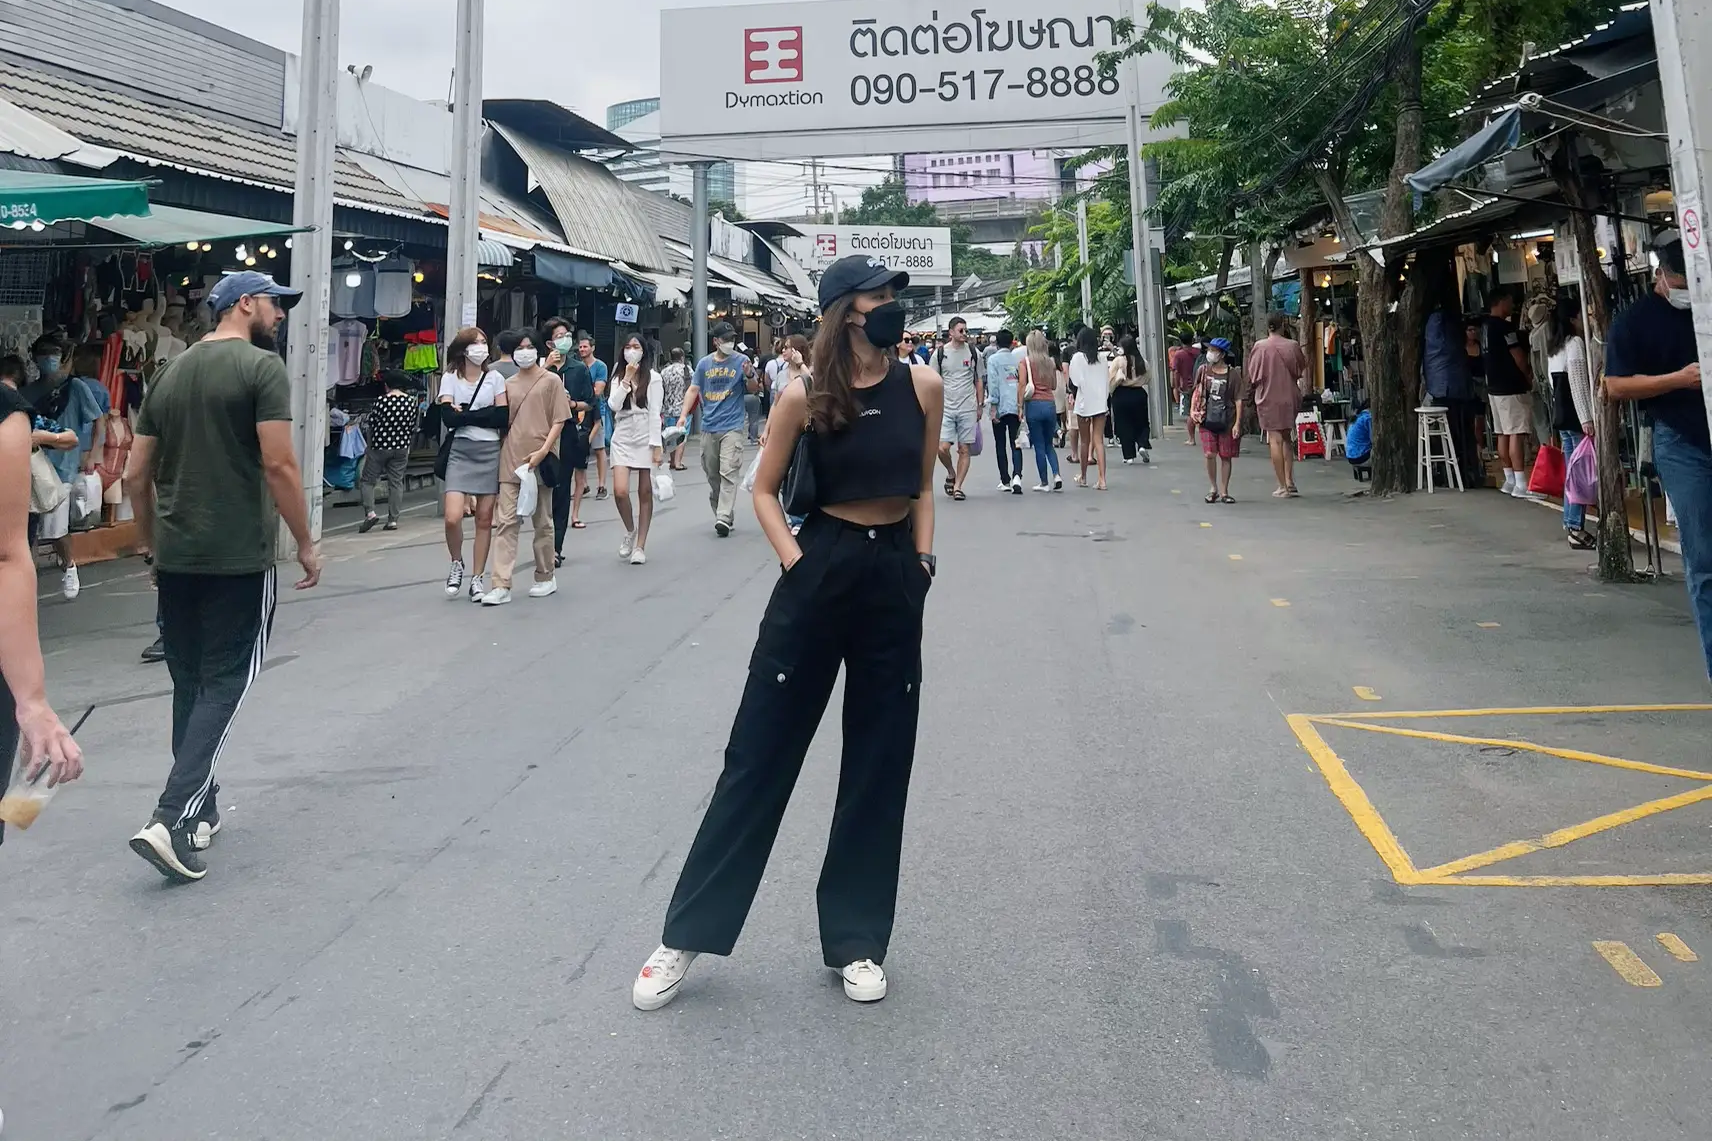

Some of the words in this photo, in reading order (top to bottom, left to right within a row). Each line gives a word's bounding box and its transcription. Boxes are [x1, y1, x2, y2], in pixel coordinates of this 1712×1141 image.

[850, 9, 1117, 58] ติดต่อโฆษณา
[850, 65, 1120, 105] 090-517-8888
[725, 90, 823, 108] Dymaxtion
[851, 232, 933, 250] ติดต่อโฆษณา
[879, 255, 934, 268] 517-8888
